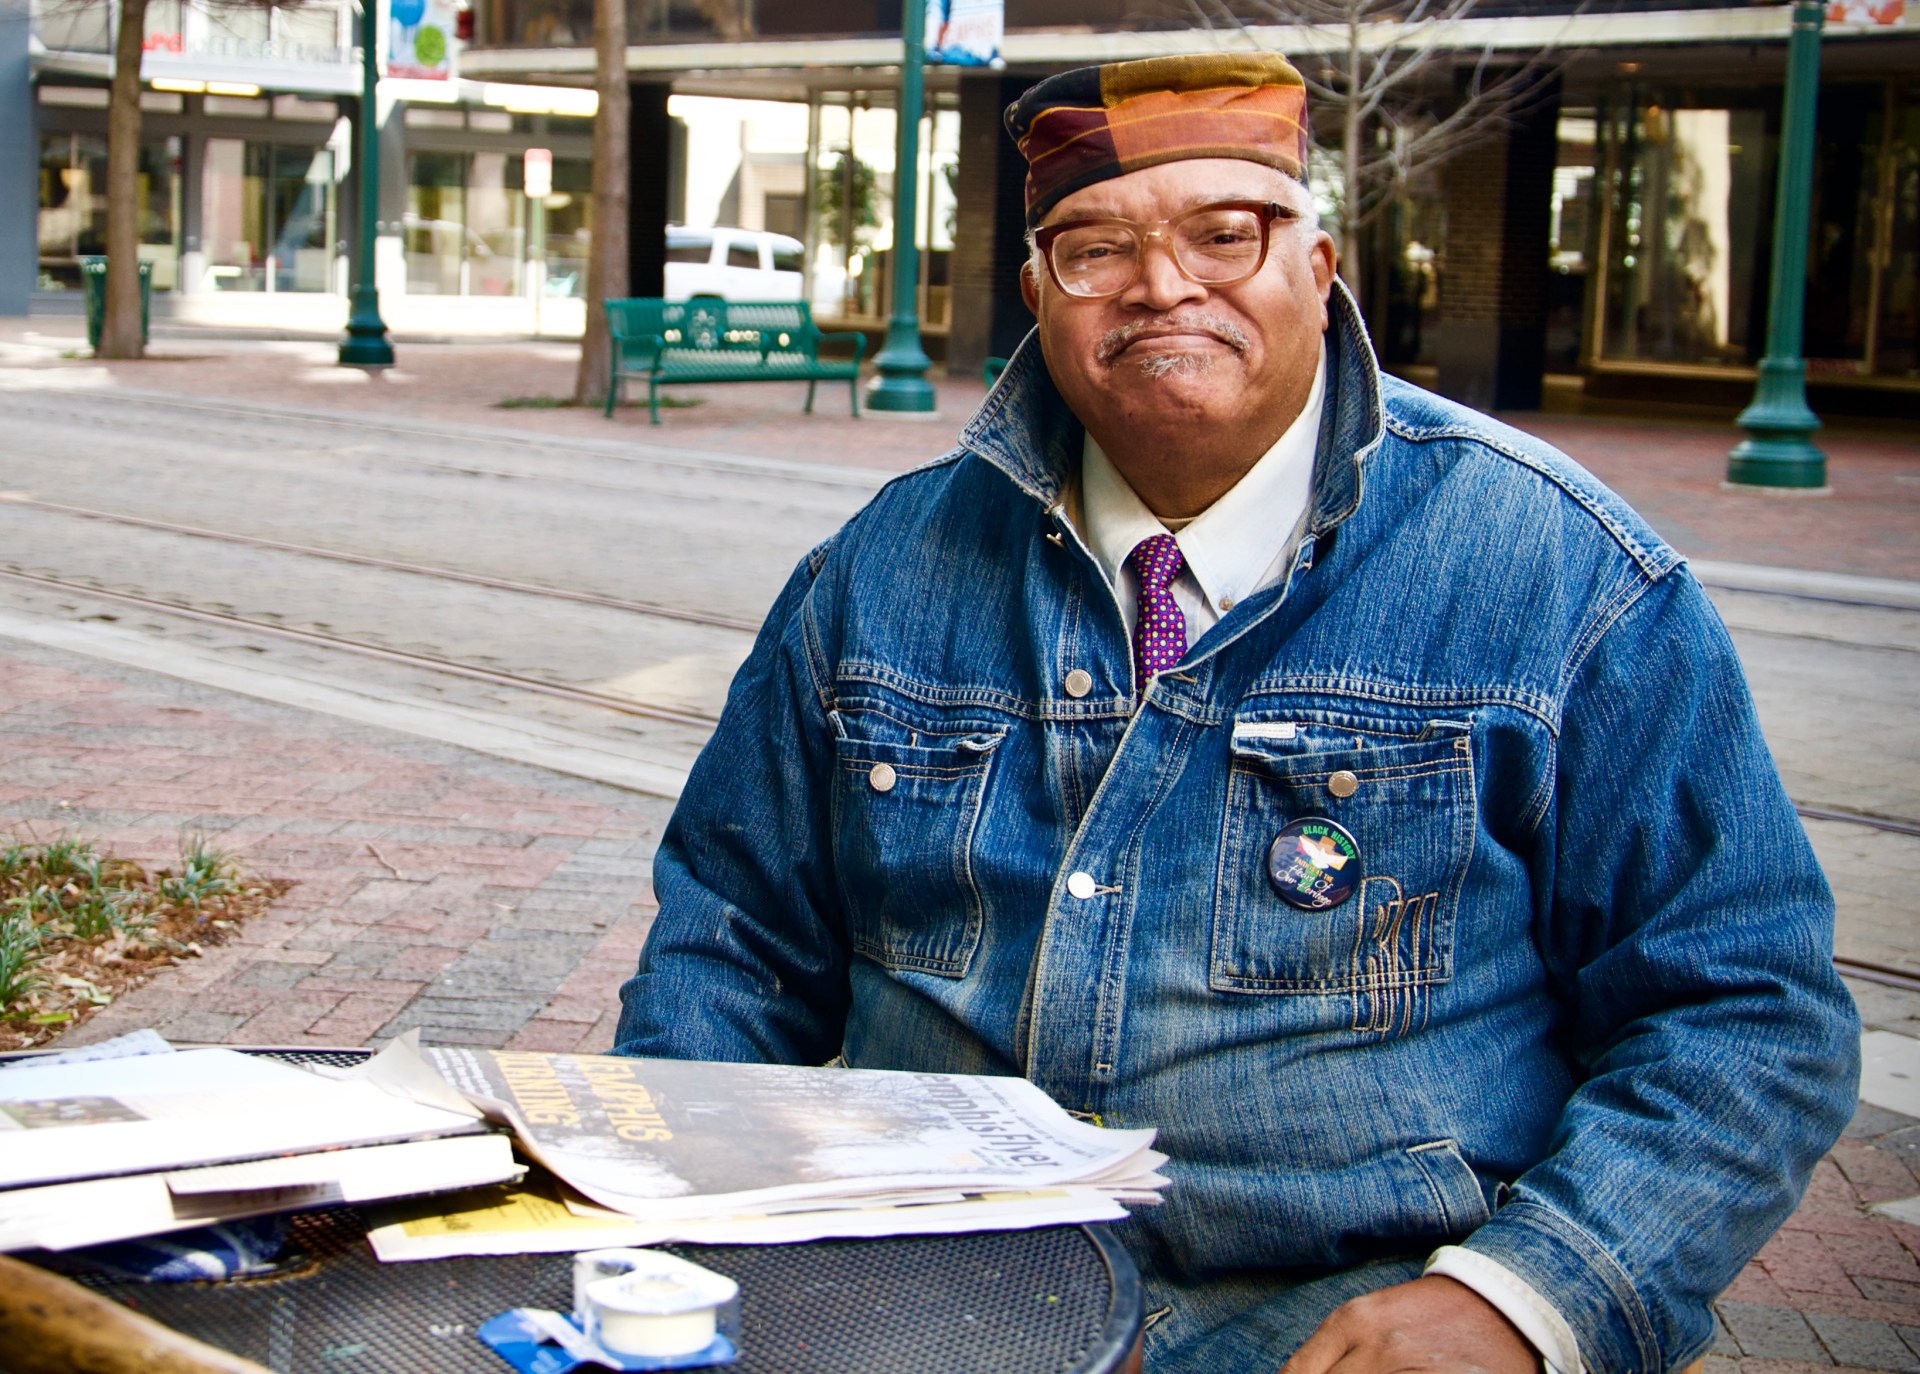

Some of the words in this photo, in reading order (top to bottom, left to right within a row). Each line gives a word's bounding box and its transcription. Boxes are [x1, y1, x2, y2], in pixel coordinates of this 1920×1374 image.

[1302, 825, 1329, 836] BLACK
[1331, 831, 1356, 859] HISTORY
[1276, 869, 1297, 884] Our
[1297, 882, 1332, 907] Heritage
[1288, 865, 1316, 881] Heart
[1315, 880, 1333, 894] Of
